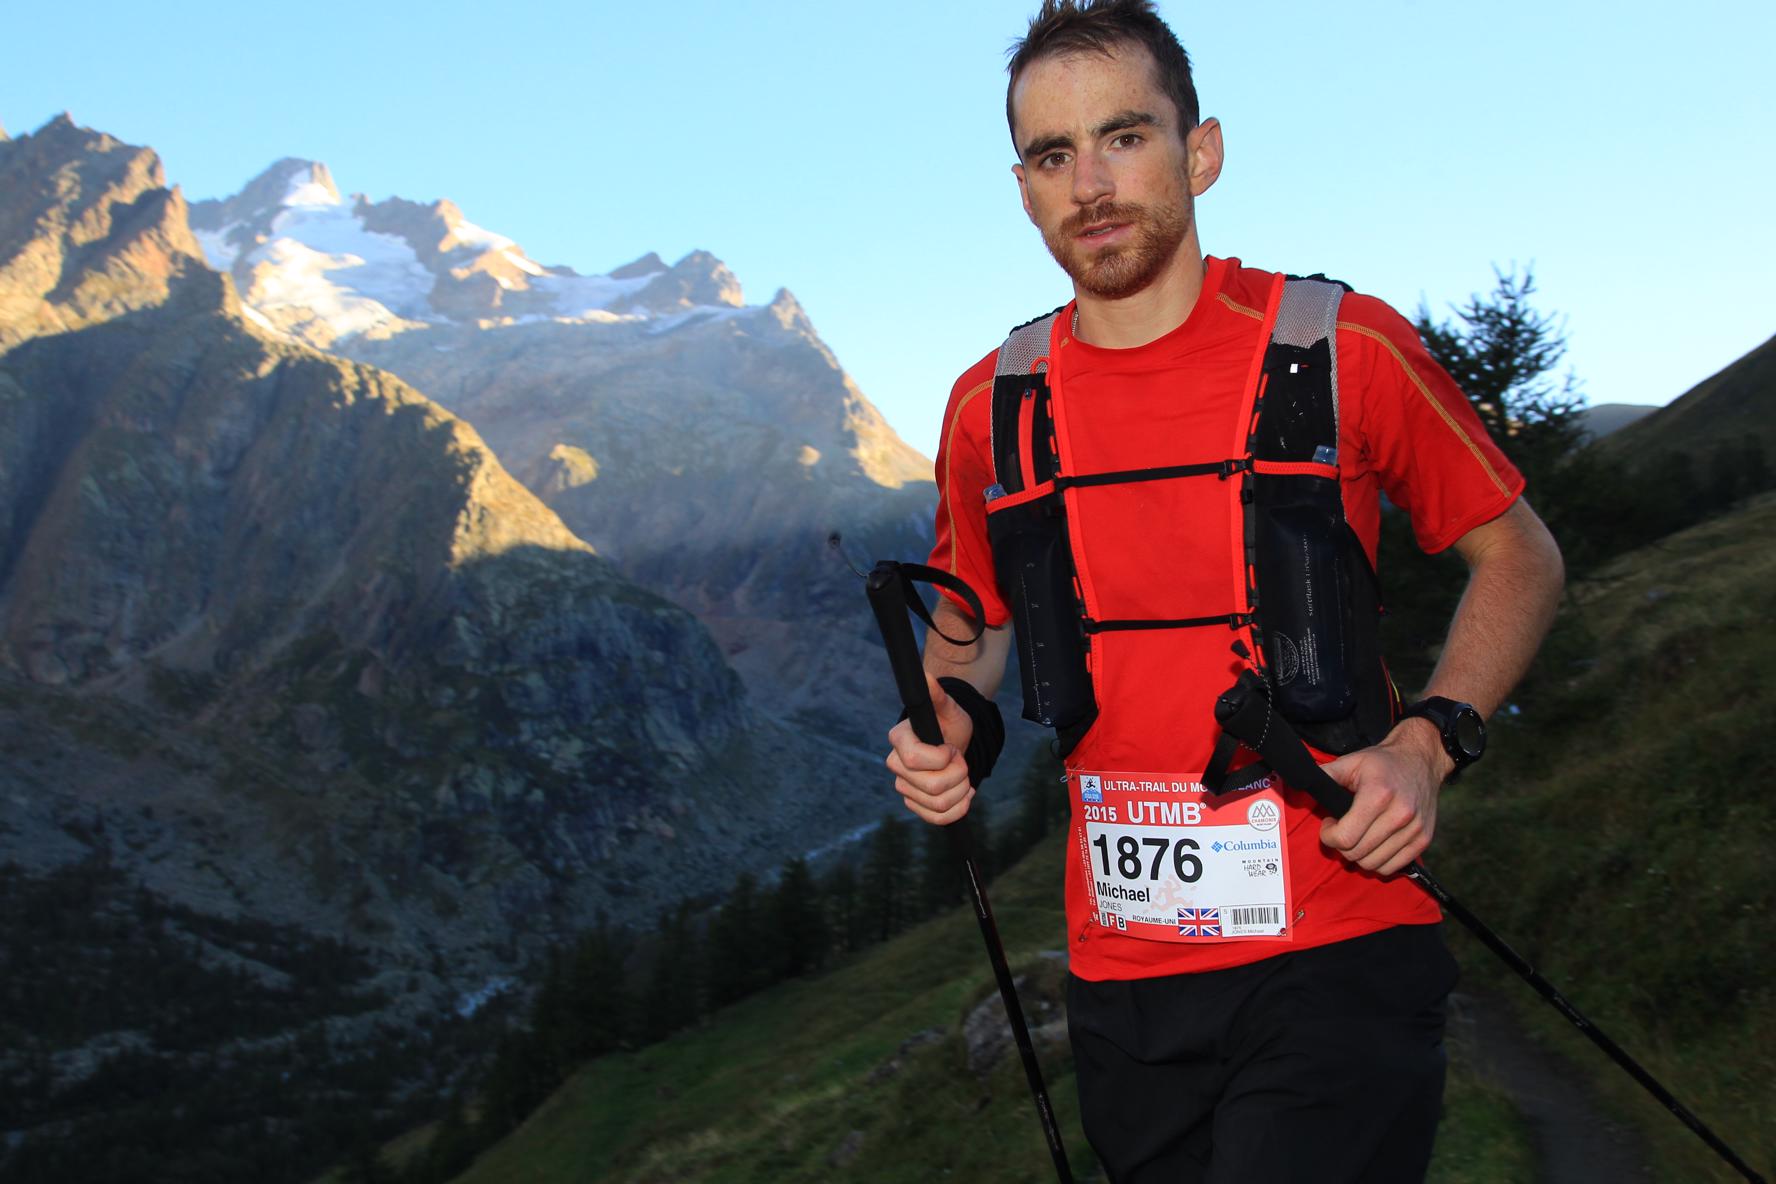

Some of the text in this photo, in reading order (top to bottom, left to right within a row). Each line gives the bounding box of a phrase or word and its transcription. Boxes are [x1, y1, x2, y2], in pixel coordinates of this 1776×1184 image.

[1103, 780, 1170, 793] ULTRA-TRAIL
[1171, 782, 1188, 793] DU
[1083, 804, 1118, 823] 2015
[1223, 839, 1278, 852] Columbia
[1093, 833, 1204, 884] 1876
[1096, 881, 1150, 903] Michael
[1099, 900, 1123, 912] JONES
[1117, 917, 1125, 929] B
[1132, 914, 1176, 925] ROYAUME-UNI
